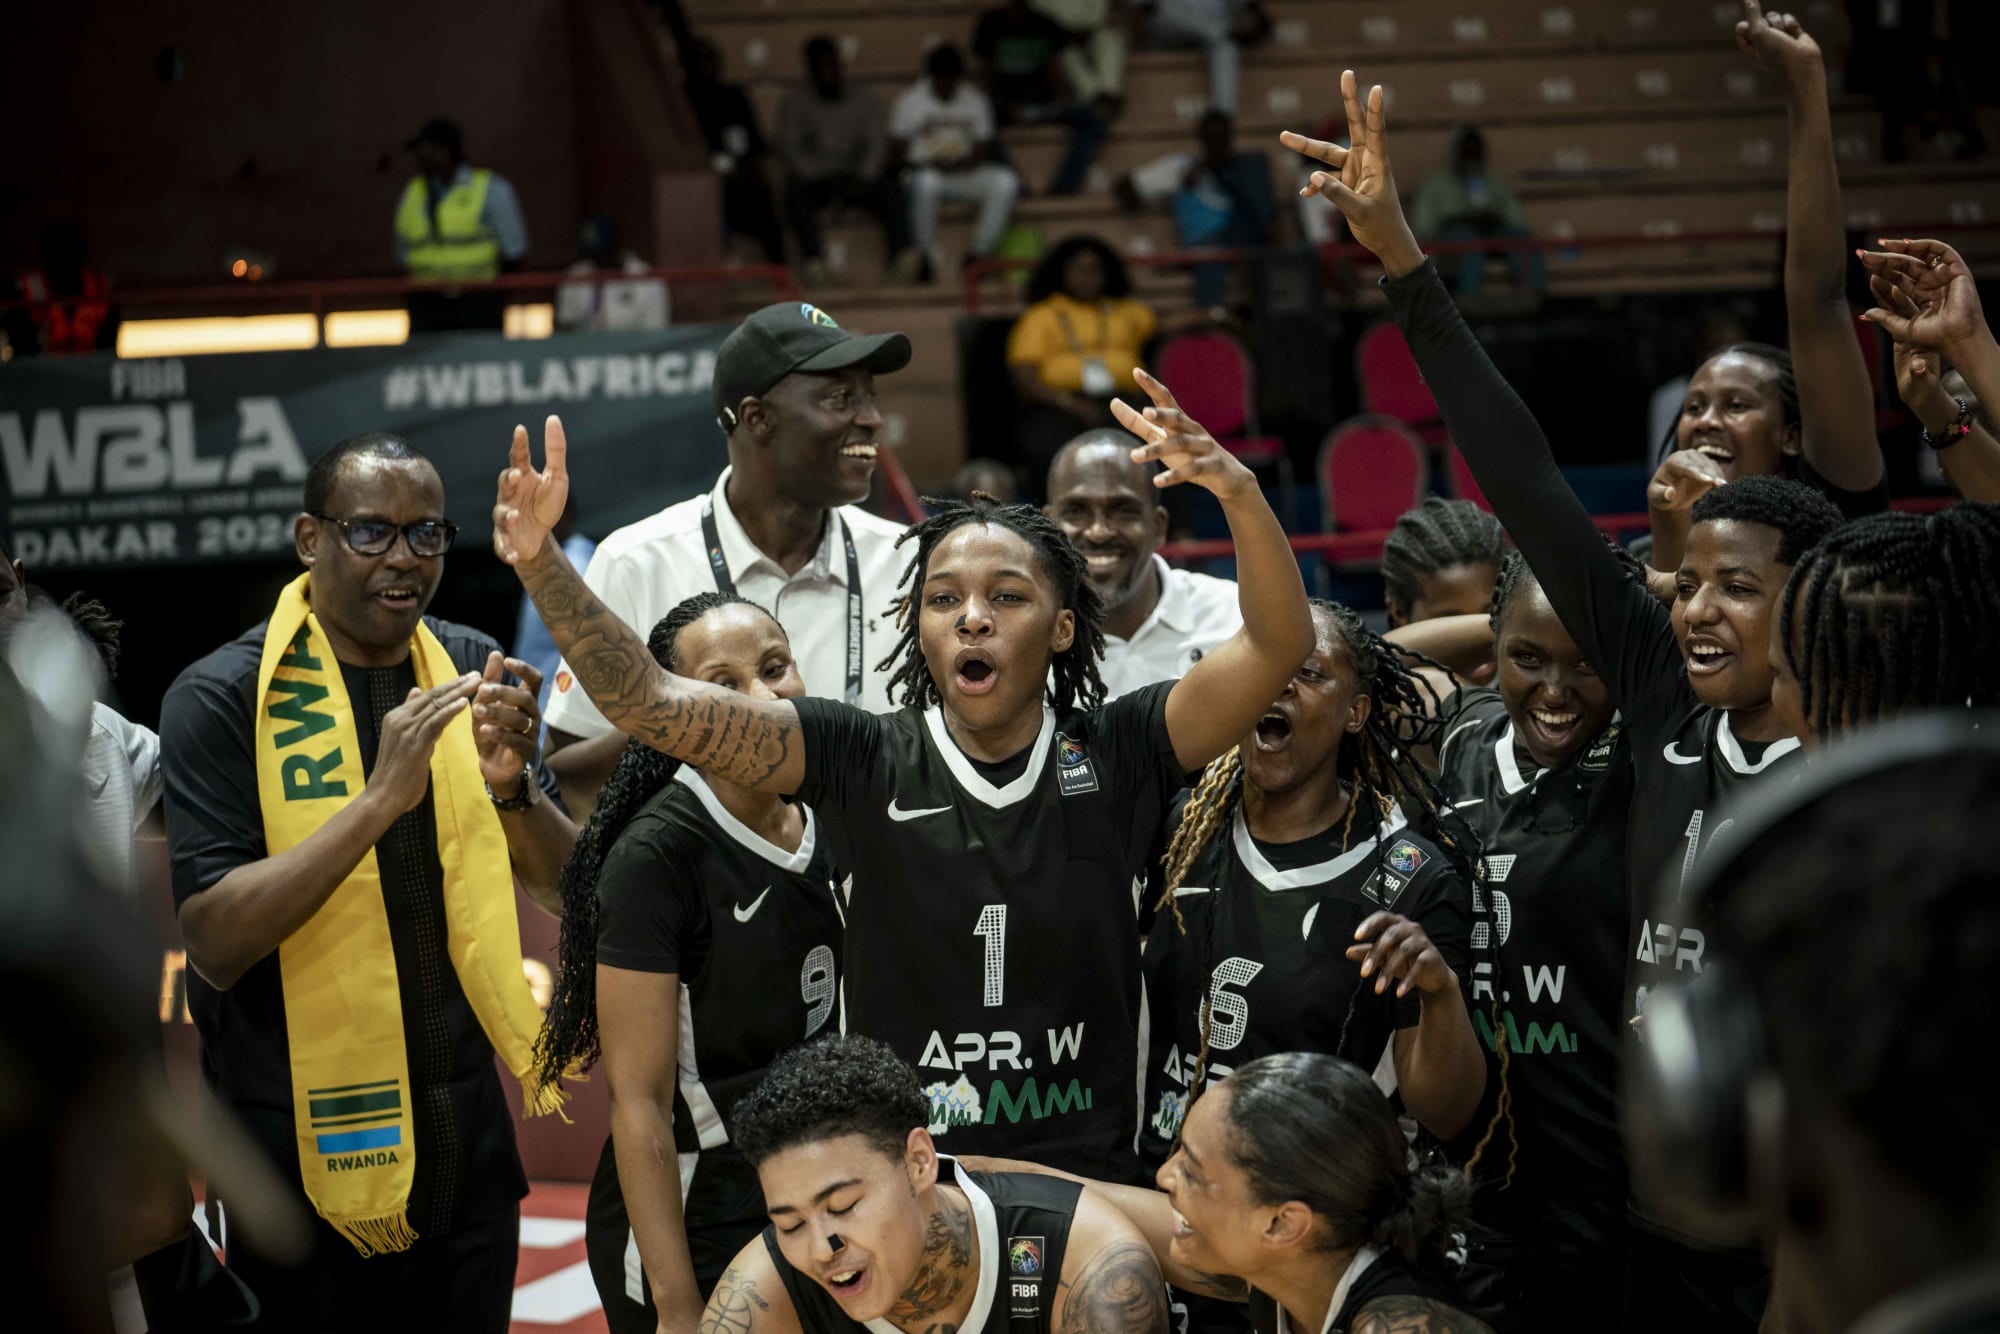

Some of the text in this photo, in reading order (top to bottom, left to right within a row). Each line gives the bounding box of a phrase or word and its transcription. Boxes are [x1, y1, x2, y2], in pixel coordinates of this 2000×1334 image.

[385, 351, 716, 408] #WBLAFRICA
[0, 395, 308, 498] WBLA
[12, 513, 295, 568] DAKAR 202
[1062, 765, 1088, 779] FIBA
[973, 904, 1007, 1007] 1
[801, 945, 835, 1040] 9
[1199, 957, 1264, 1050] 6
[1523, 965, 1566, 1004] W
[918, 1022, 1085, 1071] APR. W
[327, 1151, 399, 1172] RWANDA
[1012, 1284, 1039, 1298] FIBA
